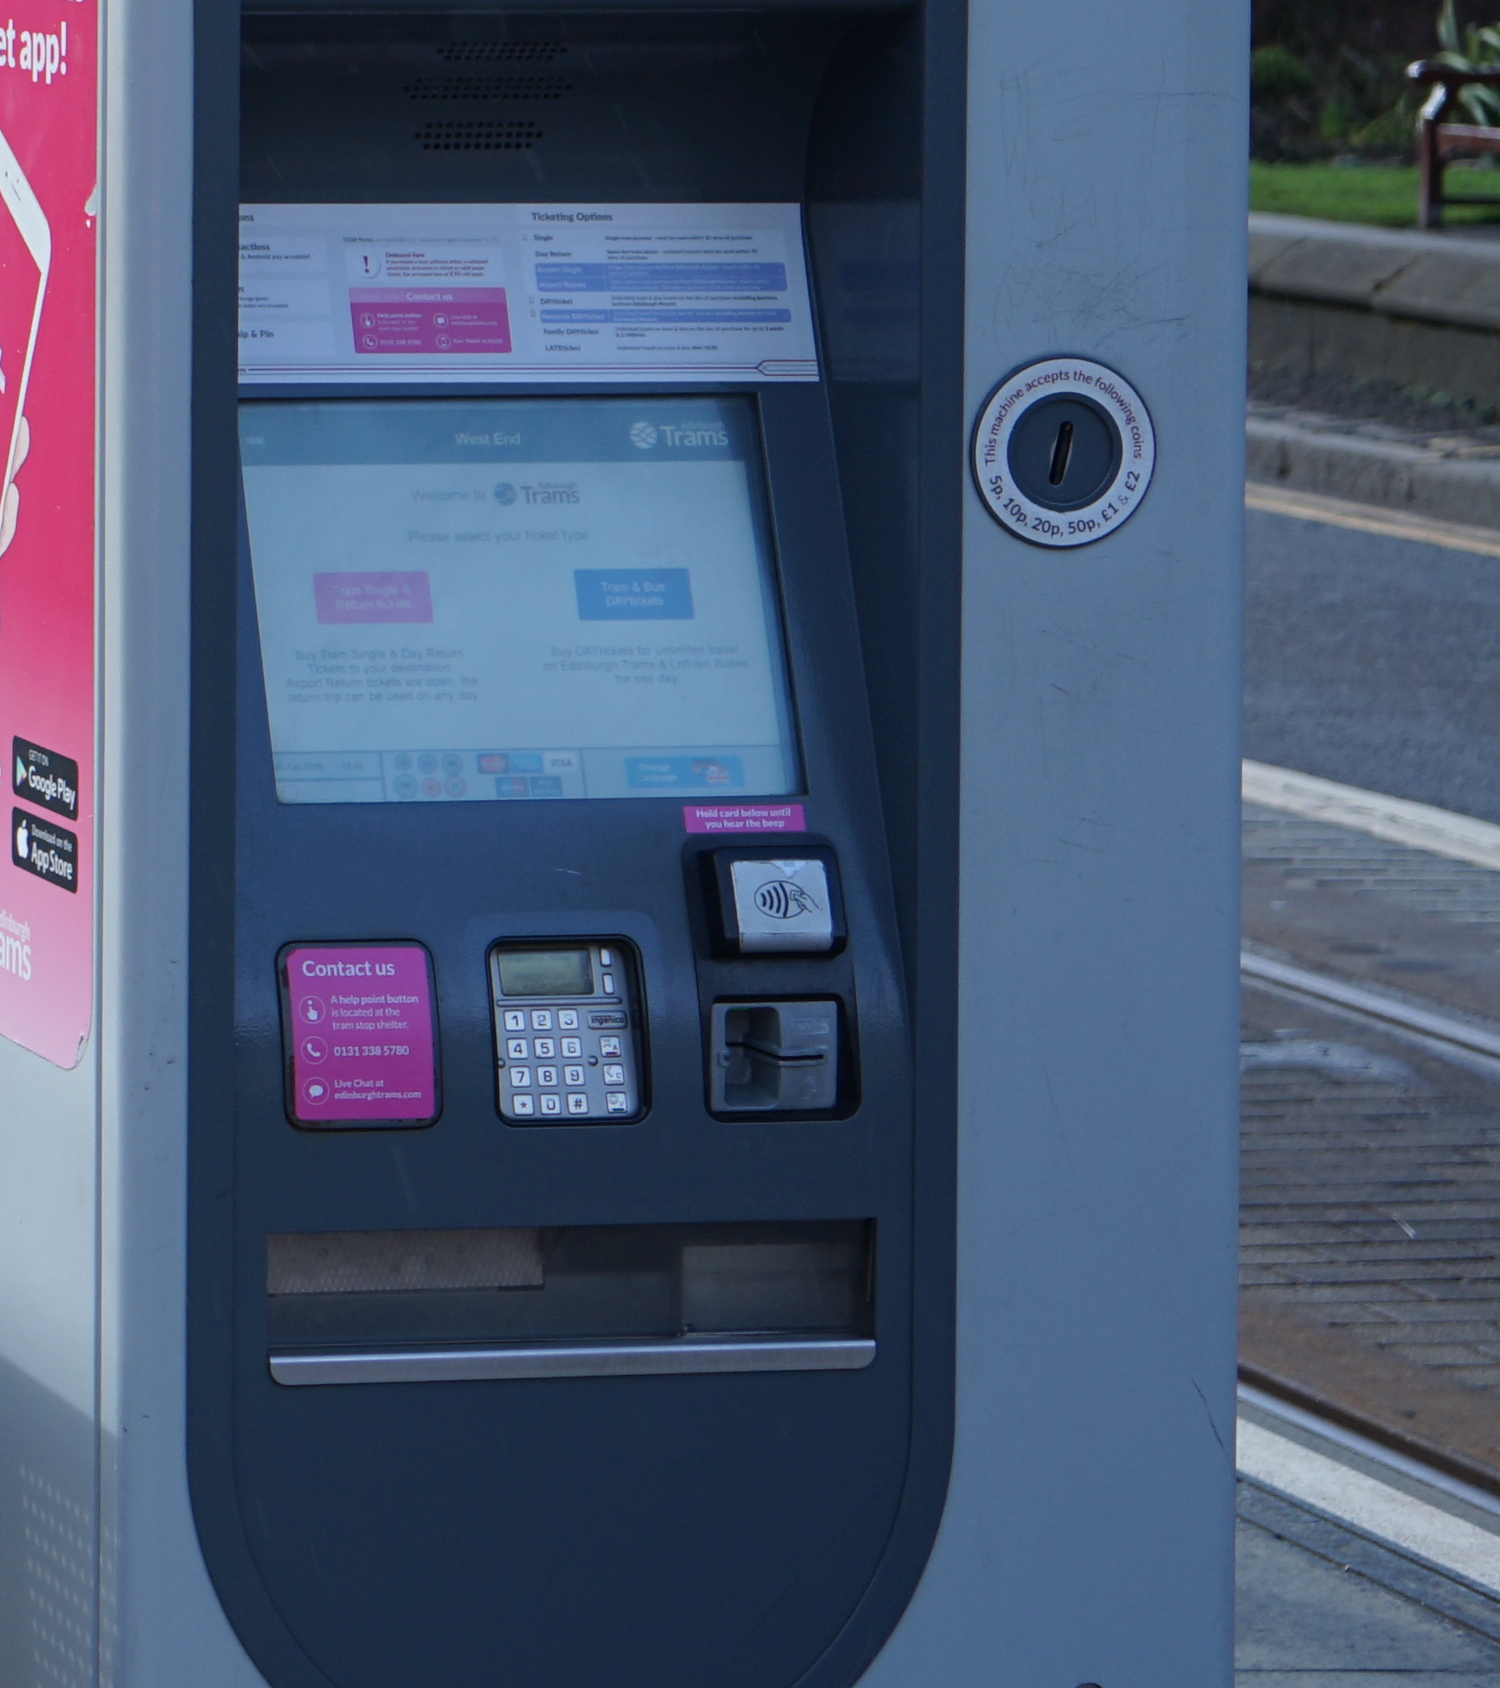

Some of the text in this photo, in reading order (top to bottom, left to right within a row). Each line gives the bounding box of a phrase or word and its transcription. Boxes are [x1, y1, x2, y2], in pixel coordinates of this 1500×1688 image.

[20, 21, 67, 85] app!
[532, 212, 613, 223] Ticketing Options
[985, 370, 1144, 466] This machine accepts the following coins
[990, 471, 1141, 537] 5p, 10p, 20p, 50p, £1 & £2
[28, 766, 76, 810] Google Play
[695, 807, 791, 819] Hold card below until
[705, 818, 785, 830] you hear the beep
[31, 824, 72, 852] Download on the
[31, 841, 73, 880] App Store
[302, 960, 395, 977] Contact us
[331, 994, 419, 1006] A help point button
[331, 1008, 400, 1017] is located at the
[332, 1021, 409, 1031] tram stop shelter.
[334, 1045, 410, 1057] 0131 338 5780
[334, 1079, 384, 1089] Live Chat at
[334, 1091, 421, 1101] edinburghtrams.com
